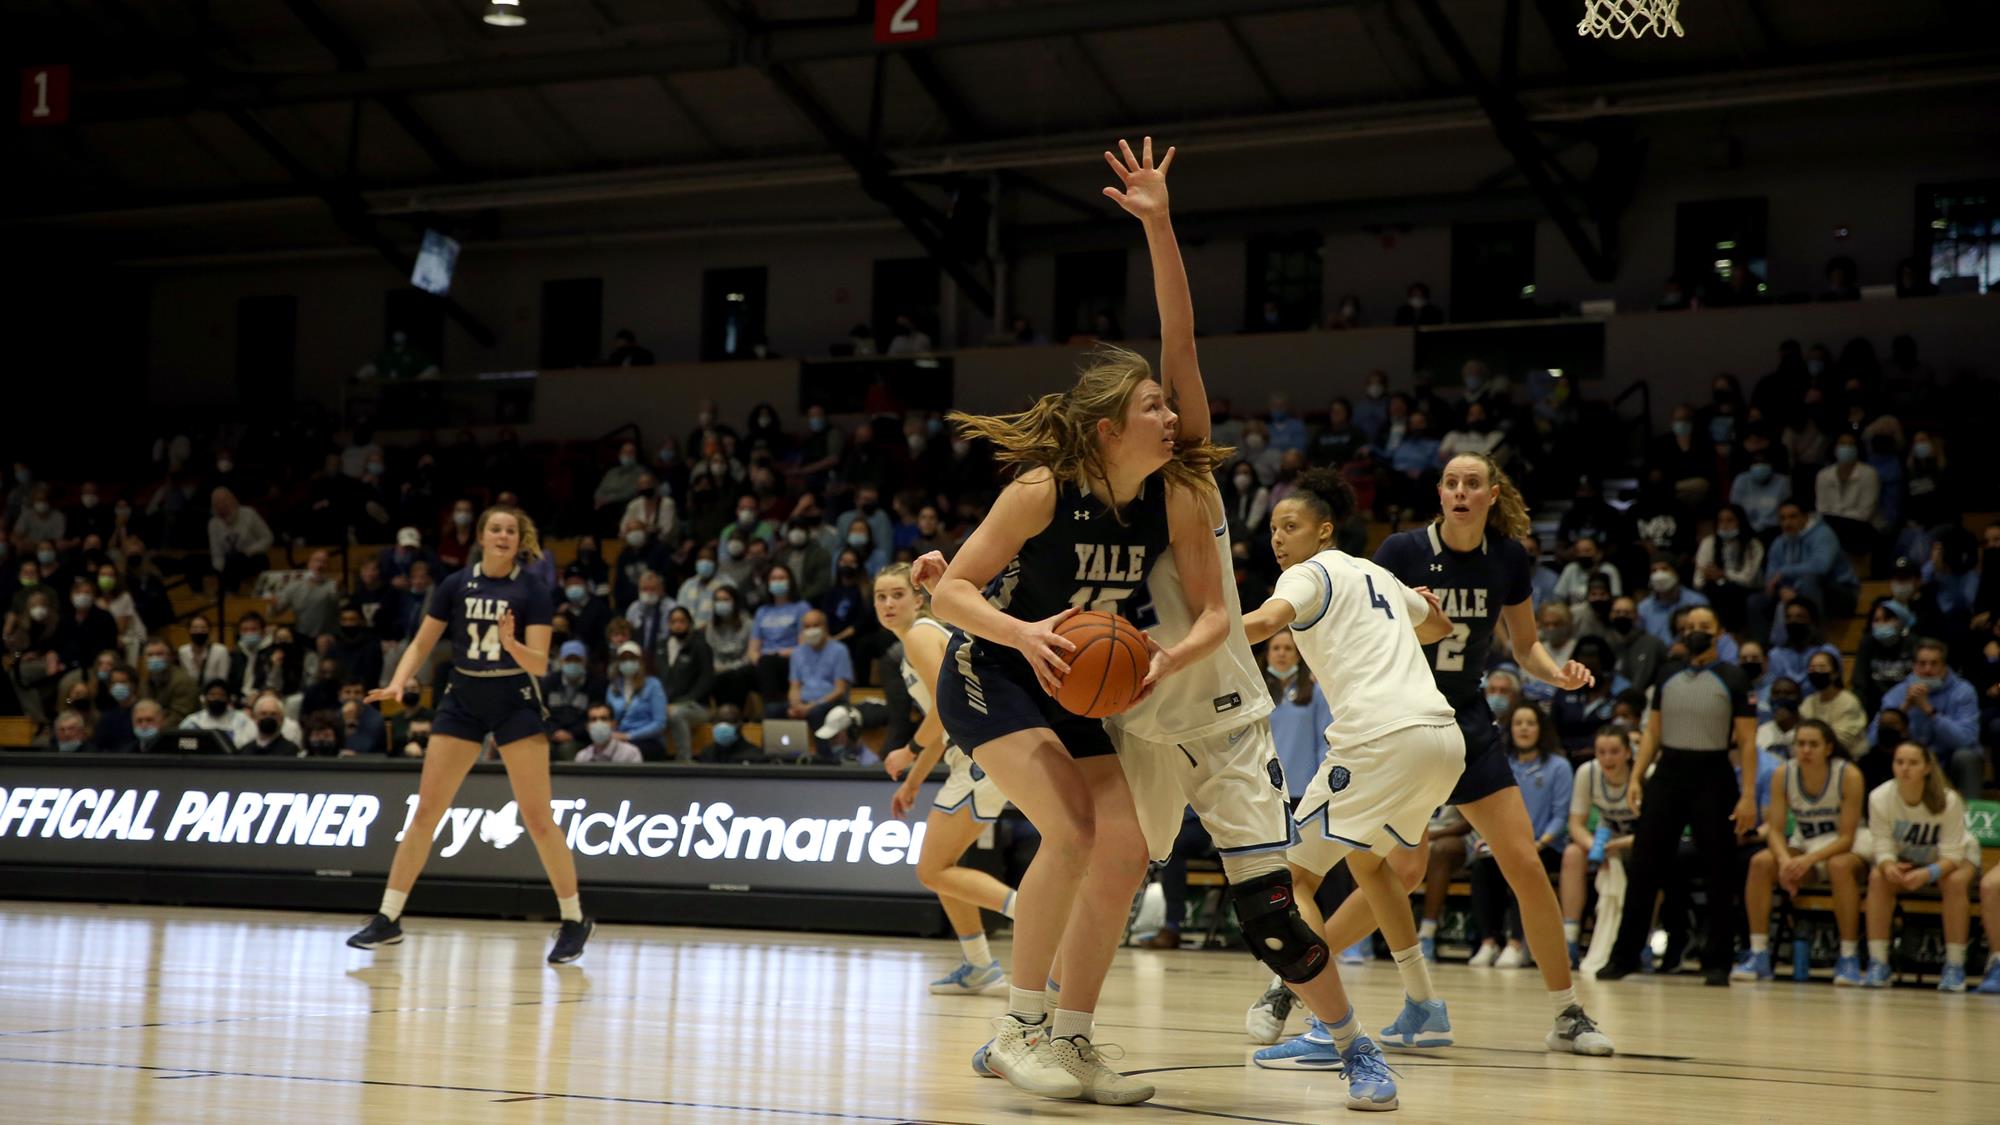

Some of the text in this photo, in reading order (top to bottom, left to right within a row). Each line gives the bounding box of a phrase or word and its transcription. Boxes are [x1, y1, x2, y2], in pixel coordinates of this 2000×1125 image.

[33, 71, 50, 118] 1
[1074, 543, 1146, 582] YALE
[464, 597, 509, 620] YALE
[1365, 574, 1394, 620] 4
[466, 622, 501, 661] 14
[1435, 622, 1472, 672] 2
[0, 787, 380, 847] FFICIAL PARTNER
